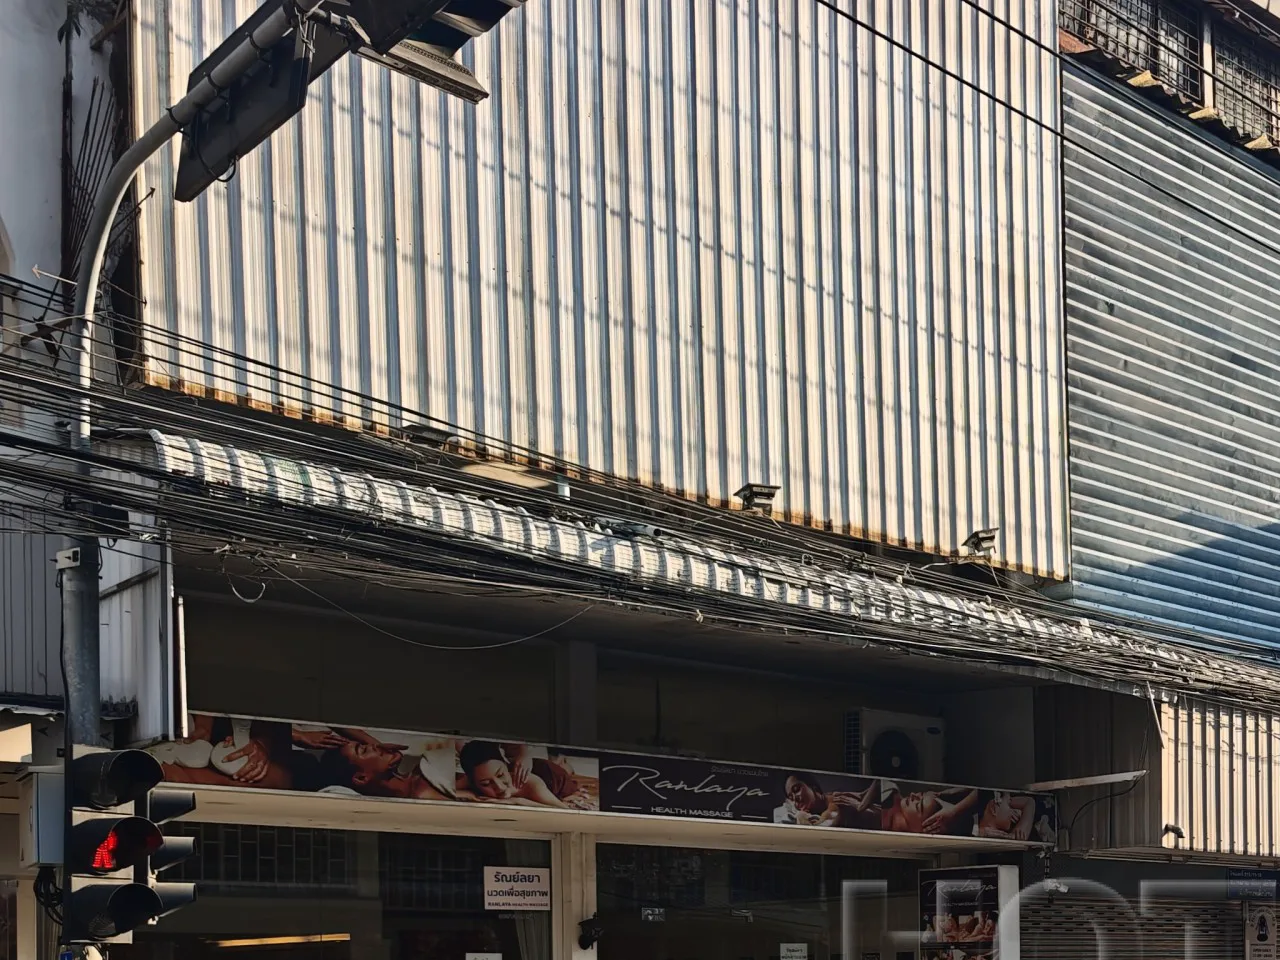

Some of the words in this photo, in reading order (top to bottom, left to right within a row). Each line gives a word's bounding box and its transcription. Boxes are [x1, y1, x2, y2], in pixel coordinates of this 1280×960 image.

[602, 765, 770, 811] Ranlaya
[651, 806, 686, 816] HEALTH
[689, 809, 733, 818] MASSAGE
[494, 871, 541, 883] รัณย์ลยา
[487, 885, 549, 900] นวดเพื่อสุขภาพ
